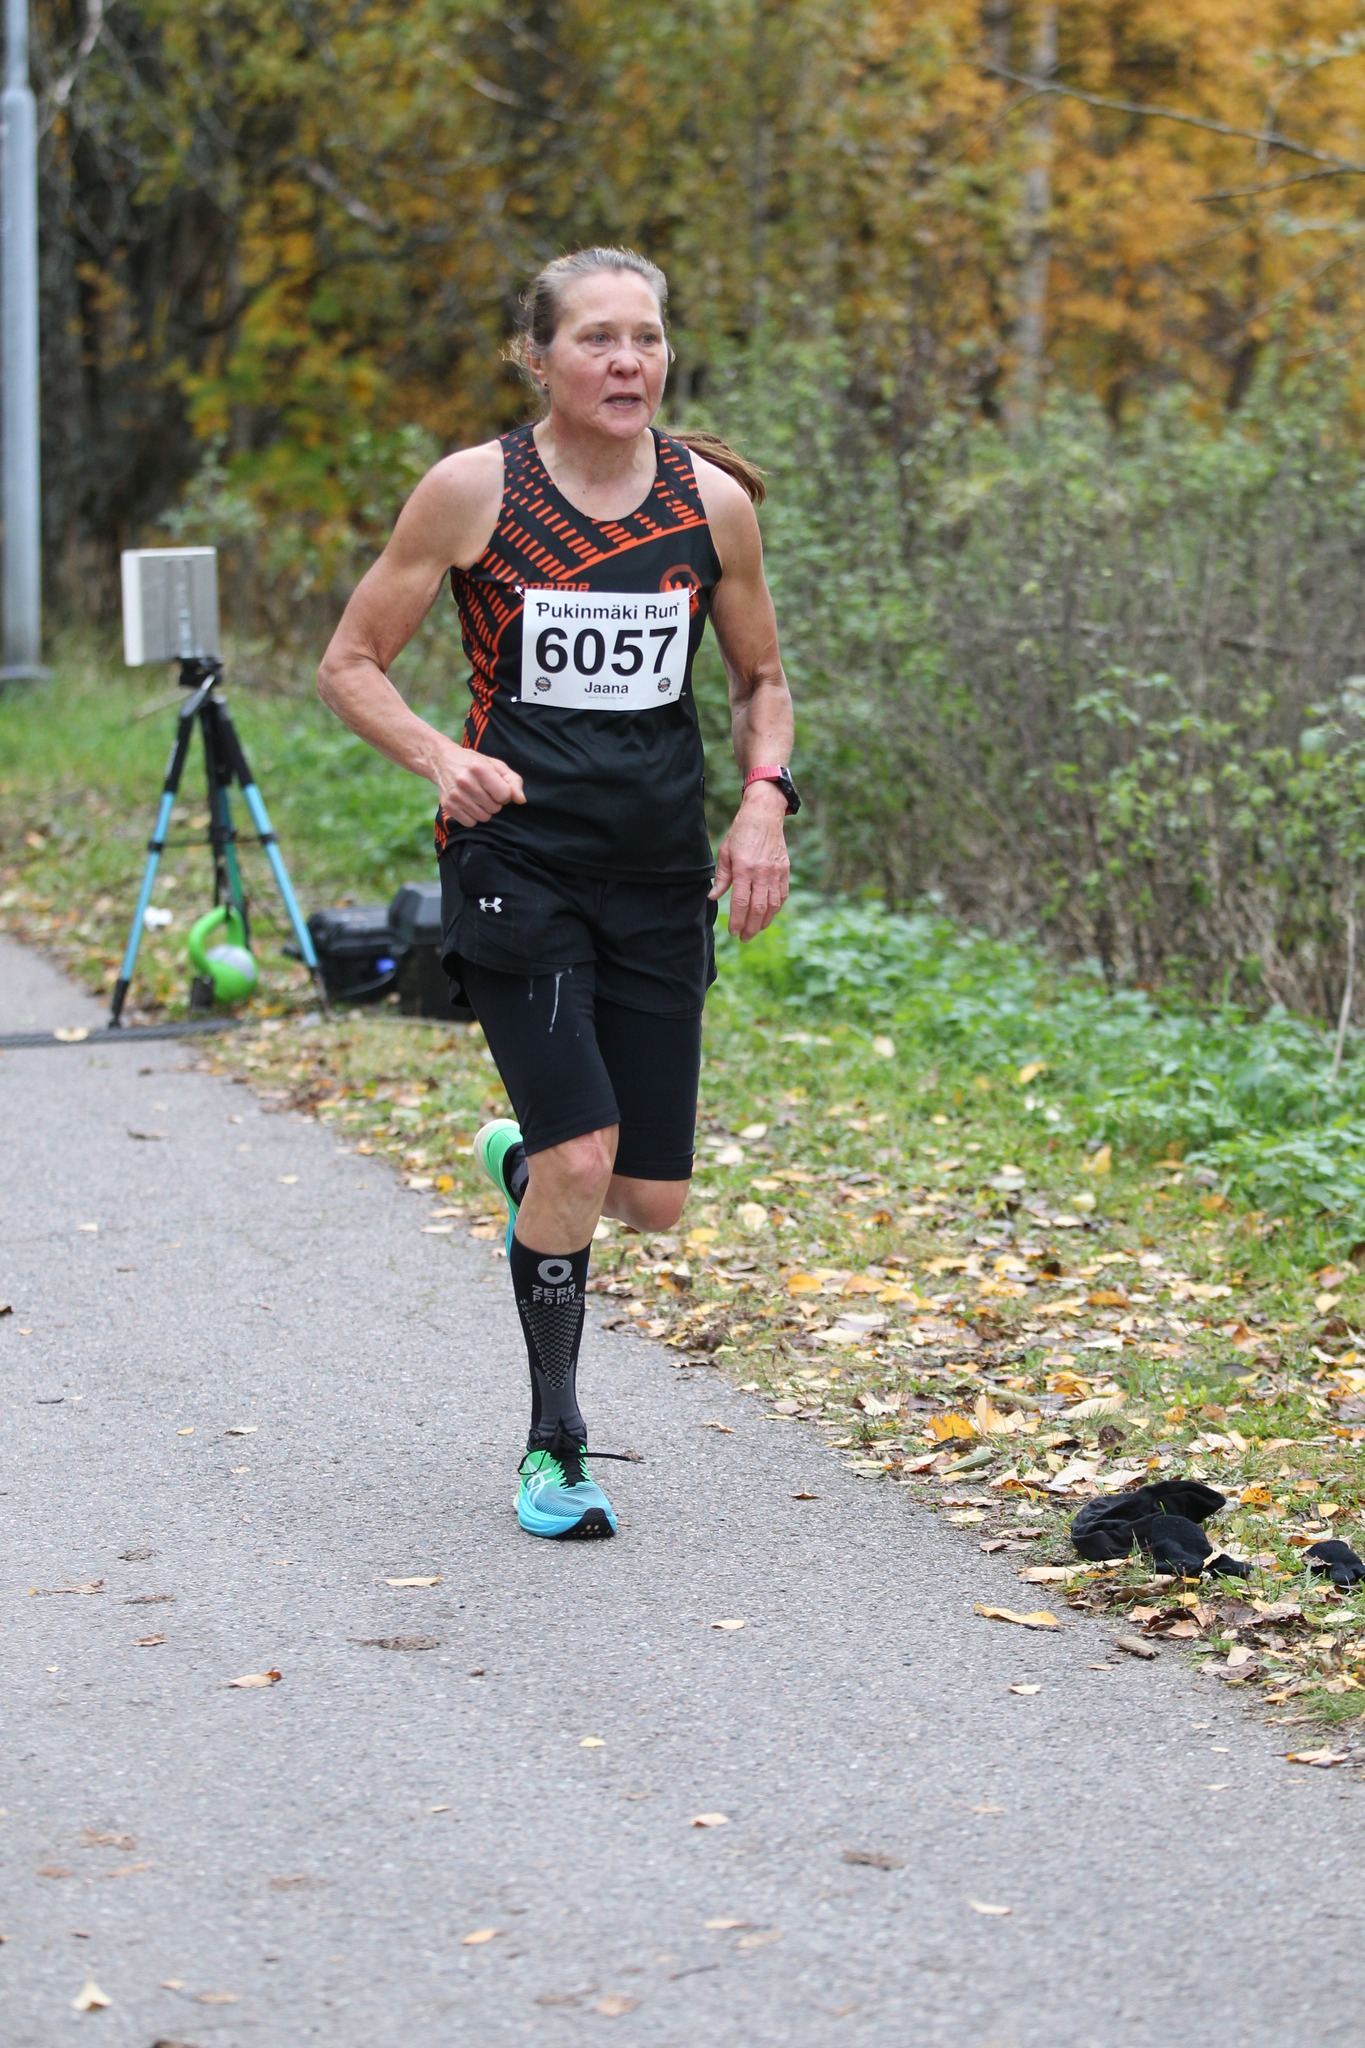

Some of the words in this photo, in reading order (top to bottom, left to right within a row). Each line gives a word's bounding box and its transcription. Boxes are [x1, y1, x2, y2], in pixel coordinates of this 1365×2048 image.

[537, 602, 638, 620] Pukinmäki
[645, 605, 679, 620] Run
[536, 626, 678, 677] 6057
[584, 681, 629, 694] Jaana
[532, 1284, 575, 1297] ZERO
[532, 1291, 575, 1305] POINT
